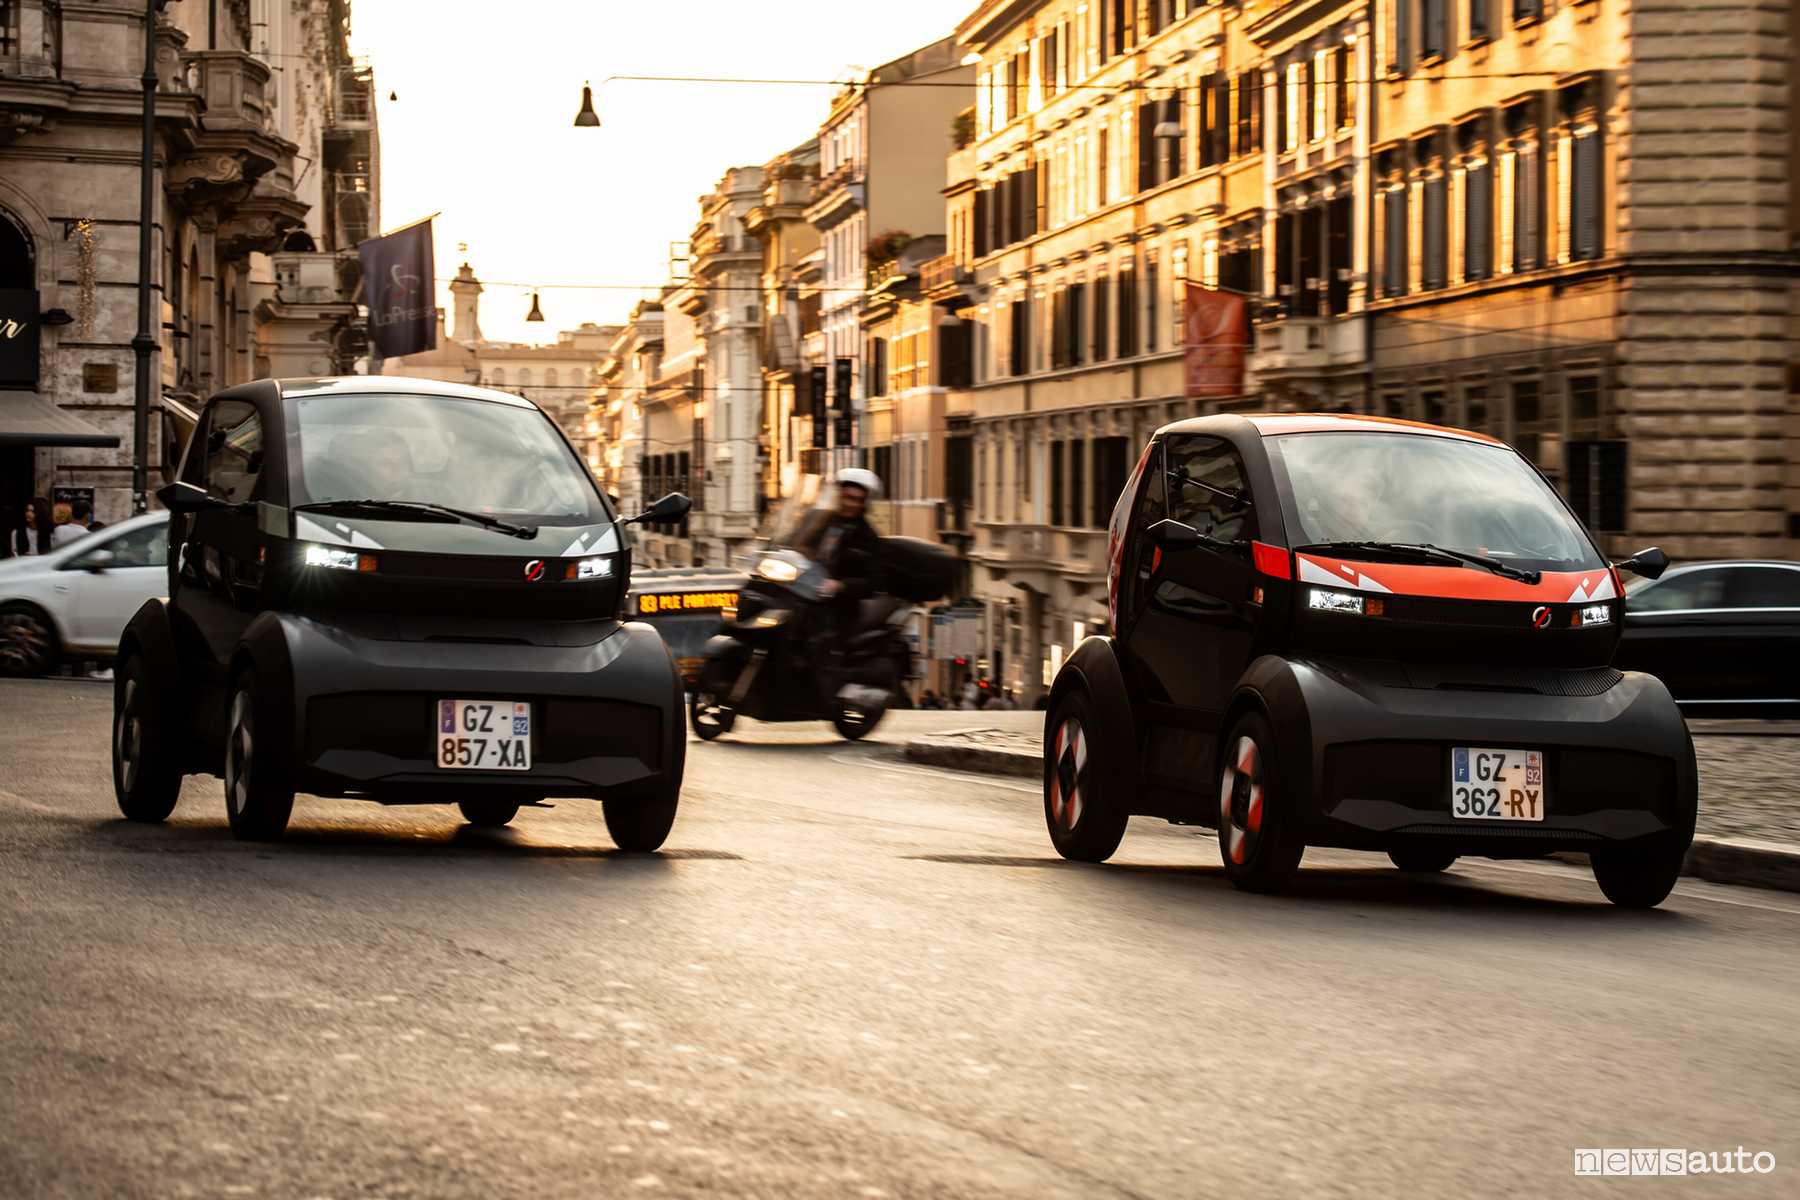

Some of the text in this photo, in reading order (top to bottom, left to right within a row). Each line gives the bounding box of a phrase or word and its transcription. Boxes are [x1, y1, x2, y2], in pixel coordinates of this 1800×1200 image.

[442, 738, 527, 768] 857-XA
[1459, 768, 1465, 777] F
[1527, 769, 1540, 782] 92
[1455, 787, 1539, 818] 362-RY
